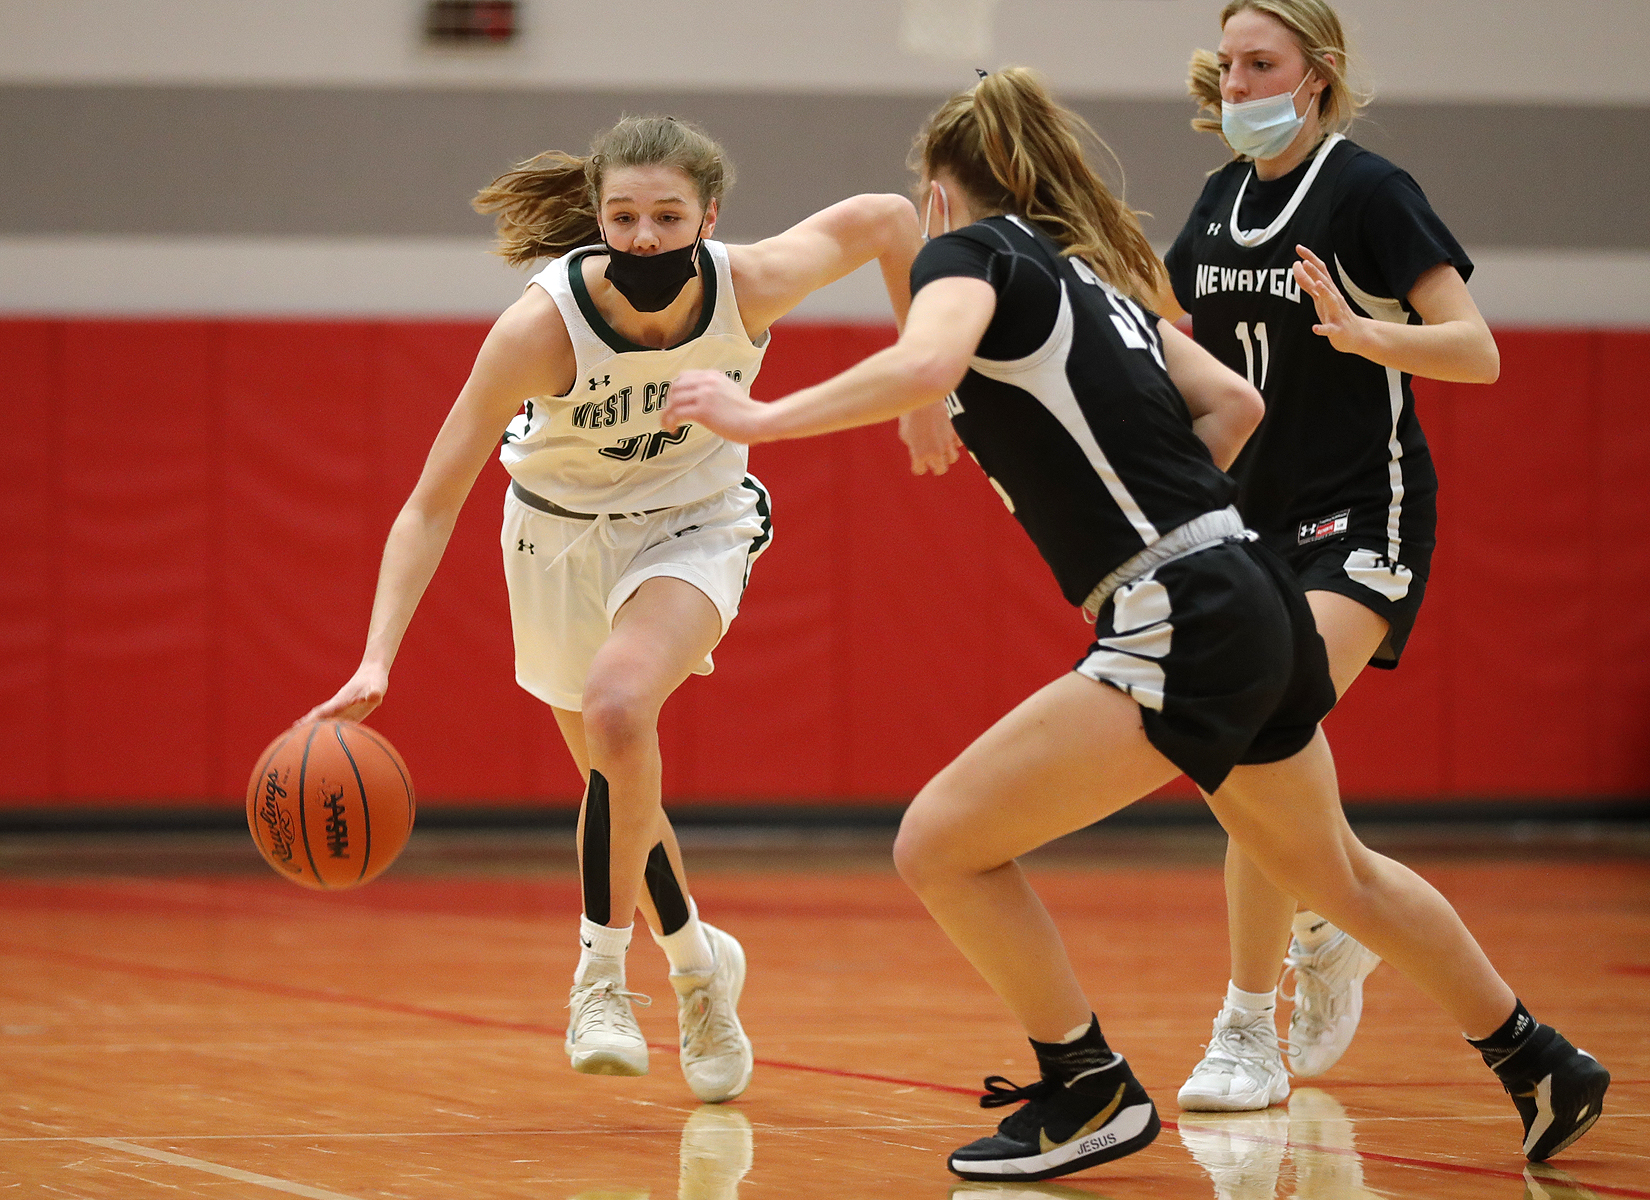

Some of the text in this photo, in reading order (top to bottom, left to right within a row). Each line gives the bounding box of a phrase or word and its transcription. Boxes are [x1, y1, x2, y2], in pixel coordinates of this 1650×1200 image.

[1195, 263, 1301, 304] NEWAYGO
[1234, 321, 1269, 391] 11
[572, 386, 633, 429] WEST
[1077, 1133, 1117, 1155] JESUS
